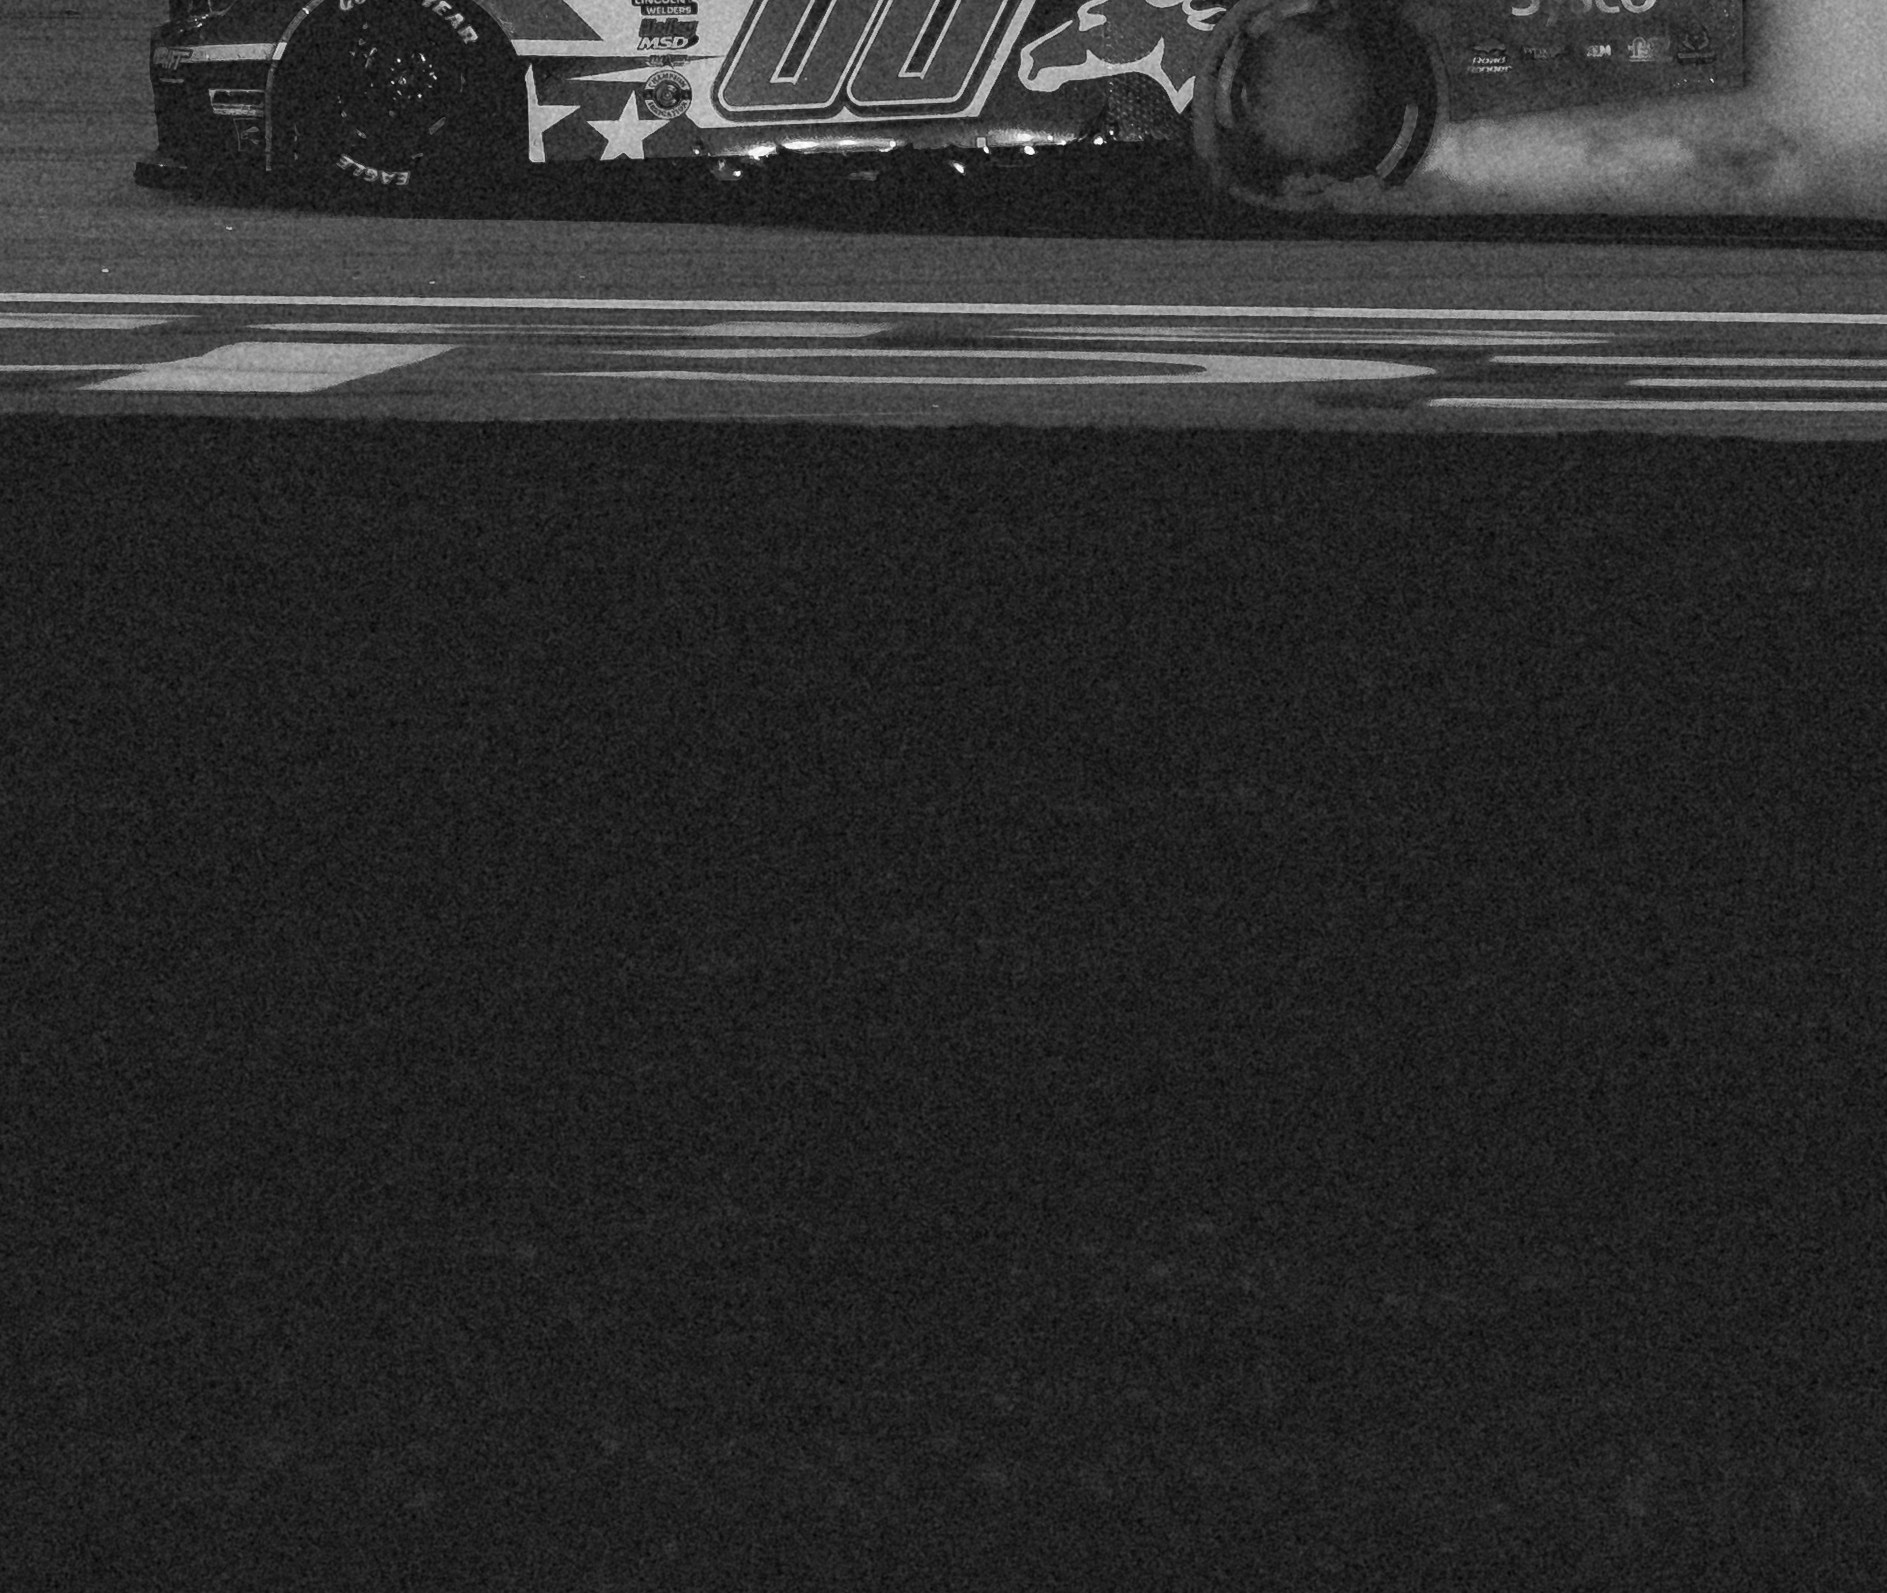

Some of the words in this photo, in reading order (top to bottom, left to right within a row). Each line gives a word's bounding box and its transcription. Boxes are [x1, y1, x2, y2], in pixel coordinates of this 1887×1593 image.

[646, 6, 692, 15] WELDERS
[638, 36, 689, 50] MSD
[647, 72, 688, 89] CHAMPION
